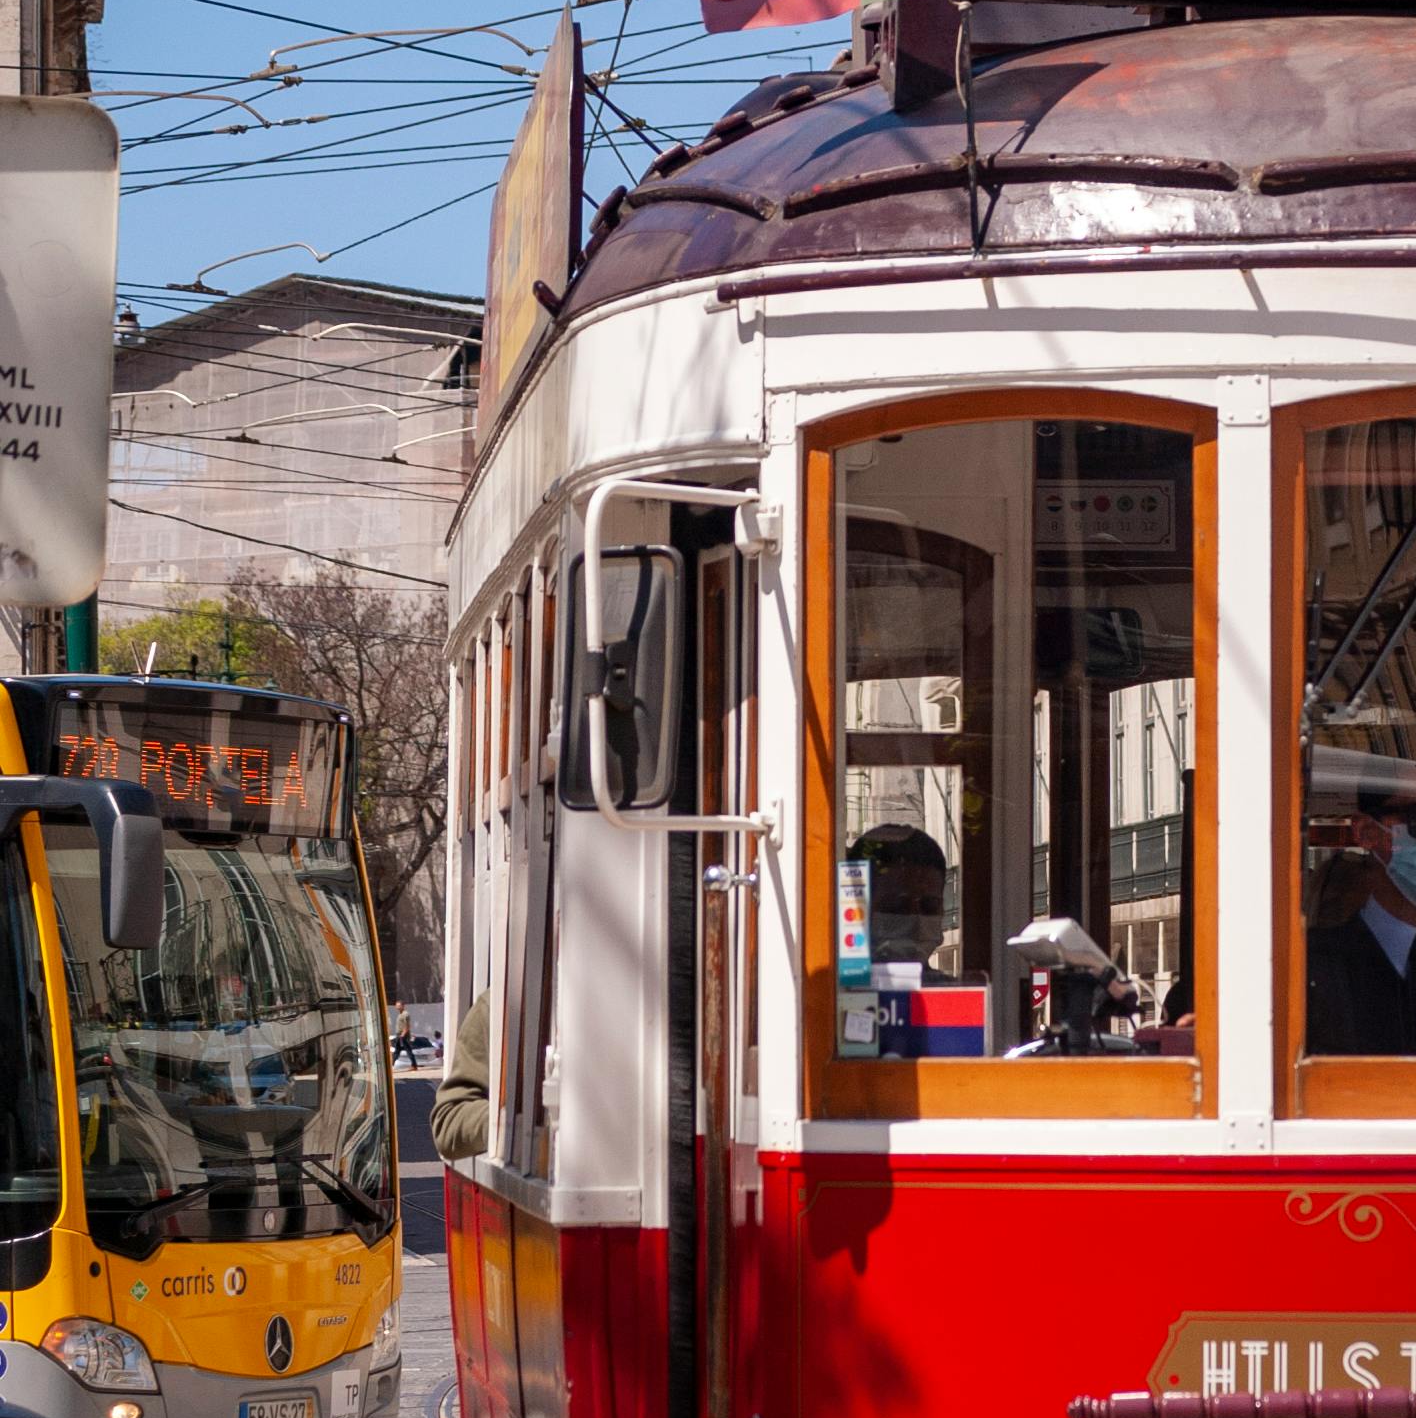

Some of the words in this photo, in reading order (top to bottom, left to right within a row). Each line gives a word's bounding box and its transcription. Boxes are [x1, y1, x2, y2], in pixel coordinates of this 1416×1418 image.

[140, 740, 307, 809] PORTELA
[162, 1266, 215, 1297] carris
[335, 1264, 361, 1285] 4822
[345, 1384, 359, 1406] TP
